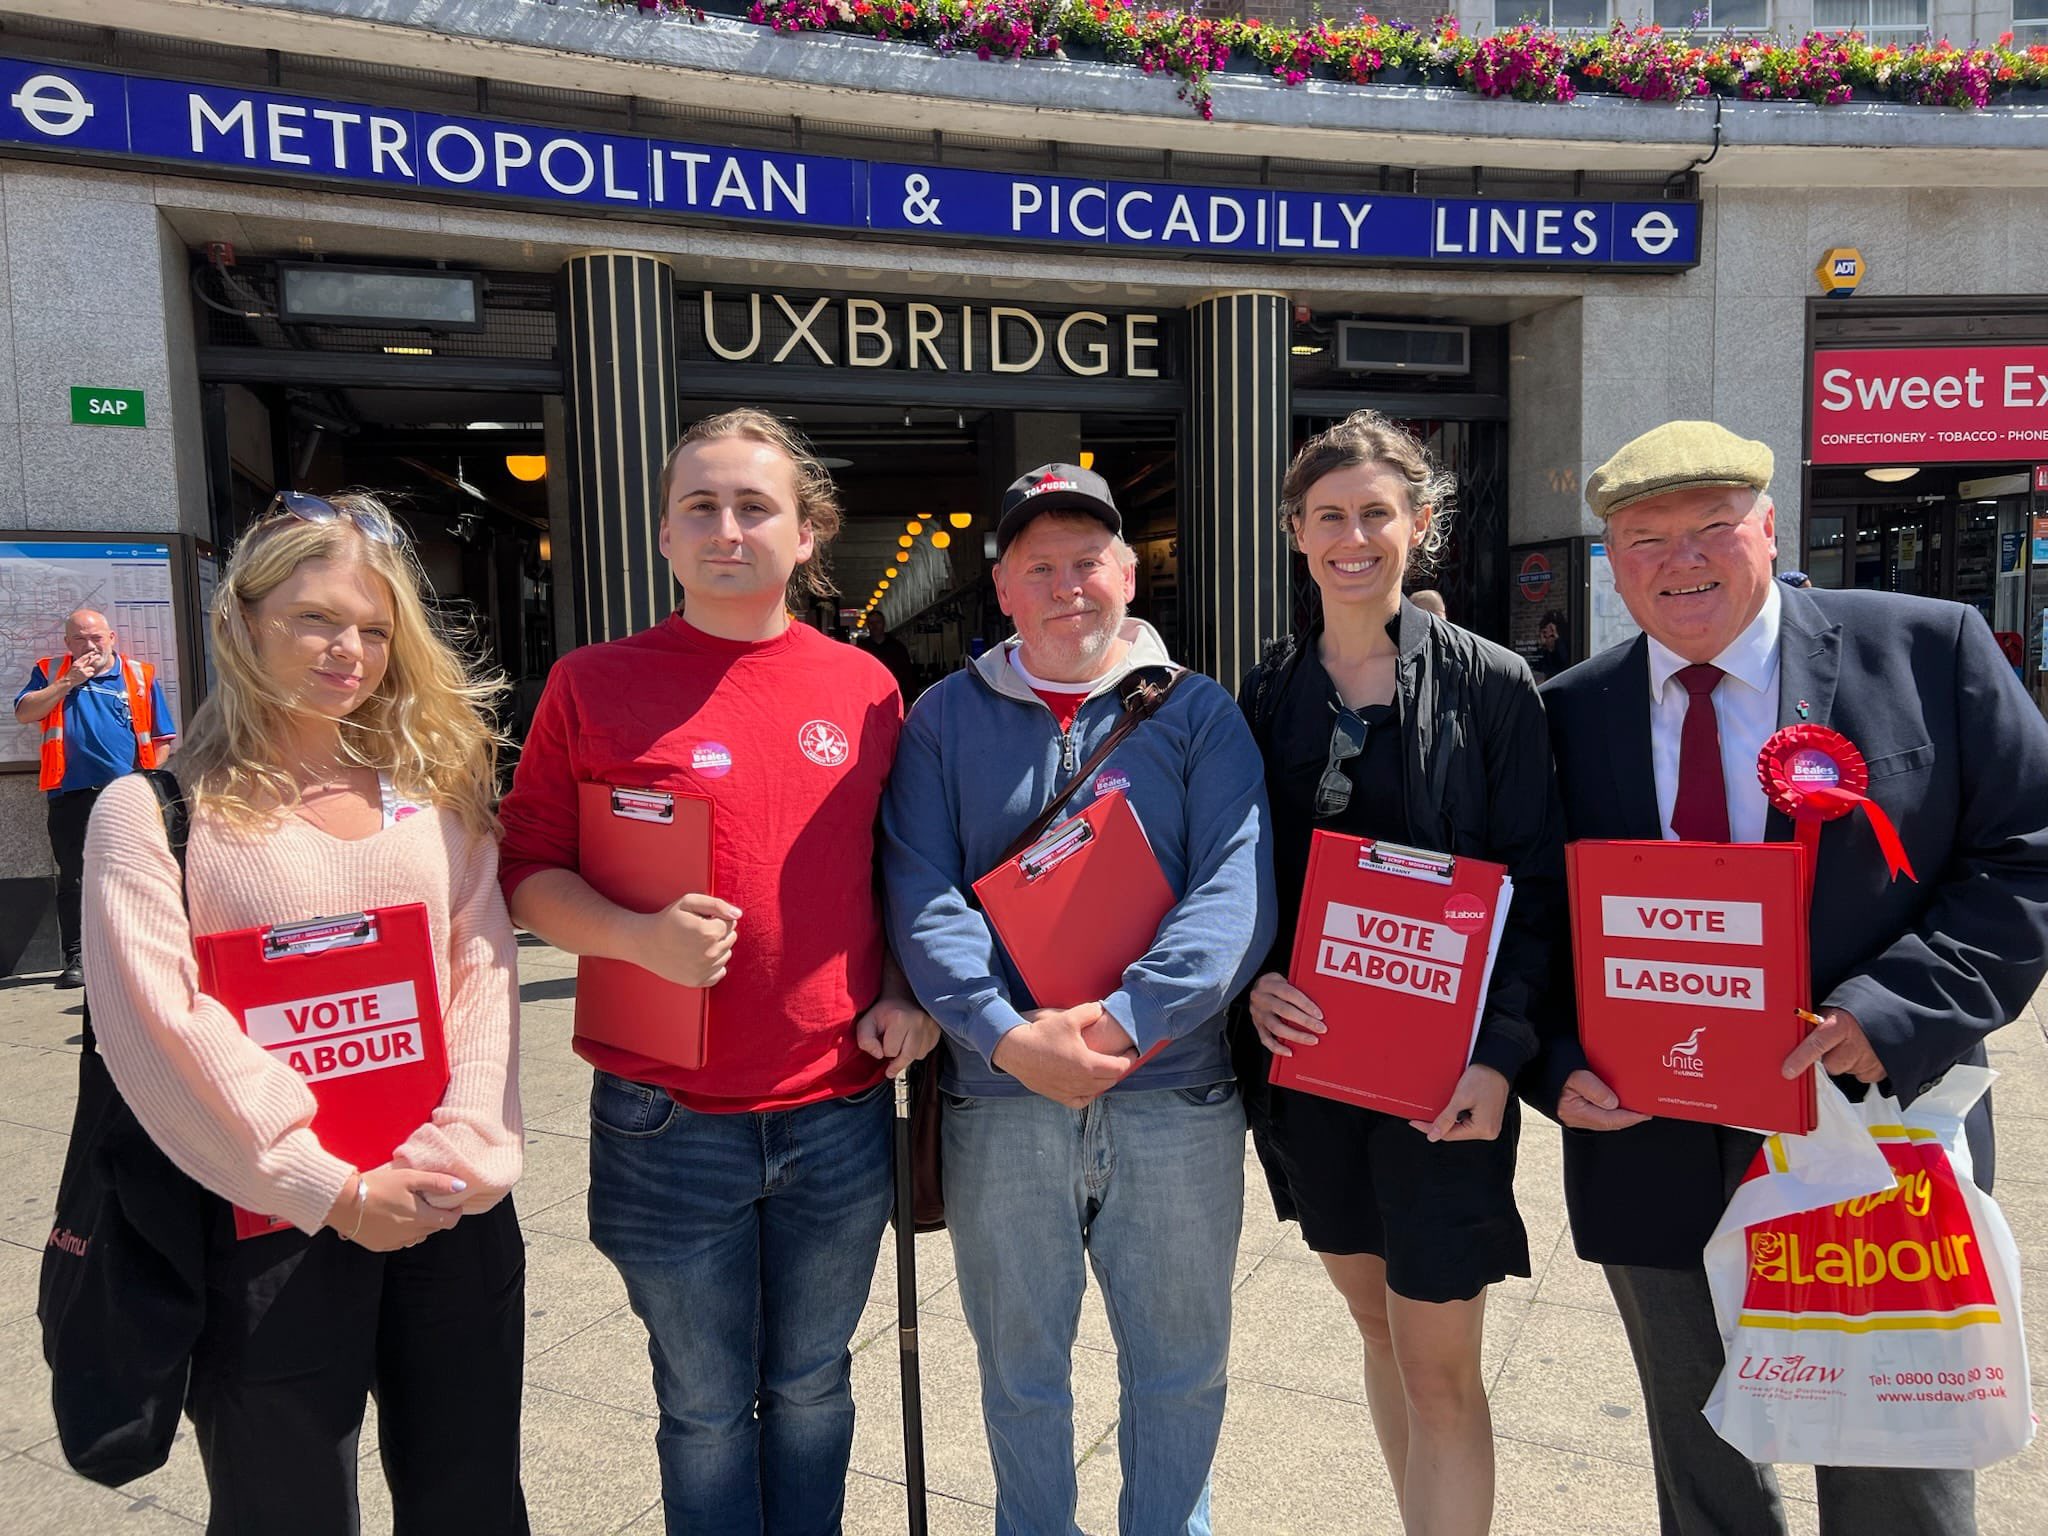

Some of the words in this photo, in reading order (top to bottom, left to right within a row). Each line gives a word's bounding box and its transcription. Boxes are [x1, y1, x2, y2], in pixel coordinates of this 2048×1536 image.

[188, 93, 807, 215] METROPOLITAN
[902, 173, 943, 225] &
[1011, 182, 1372, 249] PICCADILLY
[1436, 207, 1598, 255] LINES
[1835, 261, 1857, 275] ADT
[703, 290, 1159, 377] UXBRIDGE
[1821, 367, 1985, 411] Sweet
[89, 399, 128, 415] SAP
[1821, 432, 1927, 445] CONFECTIONERY
[1938, 430, 1997, 442] TOBACCO
[2008, 430, 2048, 441] PHONE
[1023, 481, 1079, 499] TOLPUDDLE
[1794, 765, 1834, 775] Beales
[1451, 910, 1486, 919] Labour
[1636, 907, 1725, 932] VOTE
[1356, 914, 1435, 952] VOTE
[1323, 946, 1452, 996] LABOUR
[1615, 968, 1752, 999] LABOUR
[283, 994, 380, 1034] VOTE
[288, 1032, 416, 1076] ABOUR
[1662, 1055, 1704, 1071] unite
[1657, 1096, 1718, 1110] unitetheunion.org
[1789, 1233, 1972, 1287] Labour
[1738, 1355, 1845, 1383] Usdaw
[1868, 1373, 1892, 1386] Tel:
[1895, 1372, 1934, 1386] 0800
[1937, 1371, 1966, 1386] 030
[1985, 1366, 2004, 1381] 30
[1876, 1385, 2007, 1403] www.usdaw.org.uk
